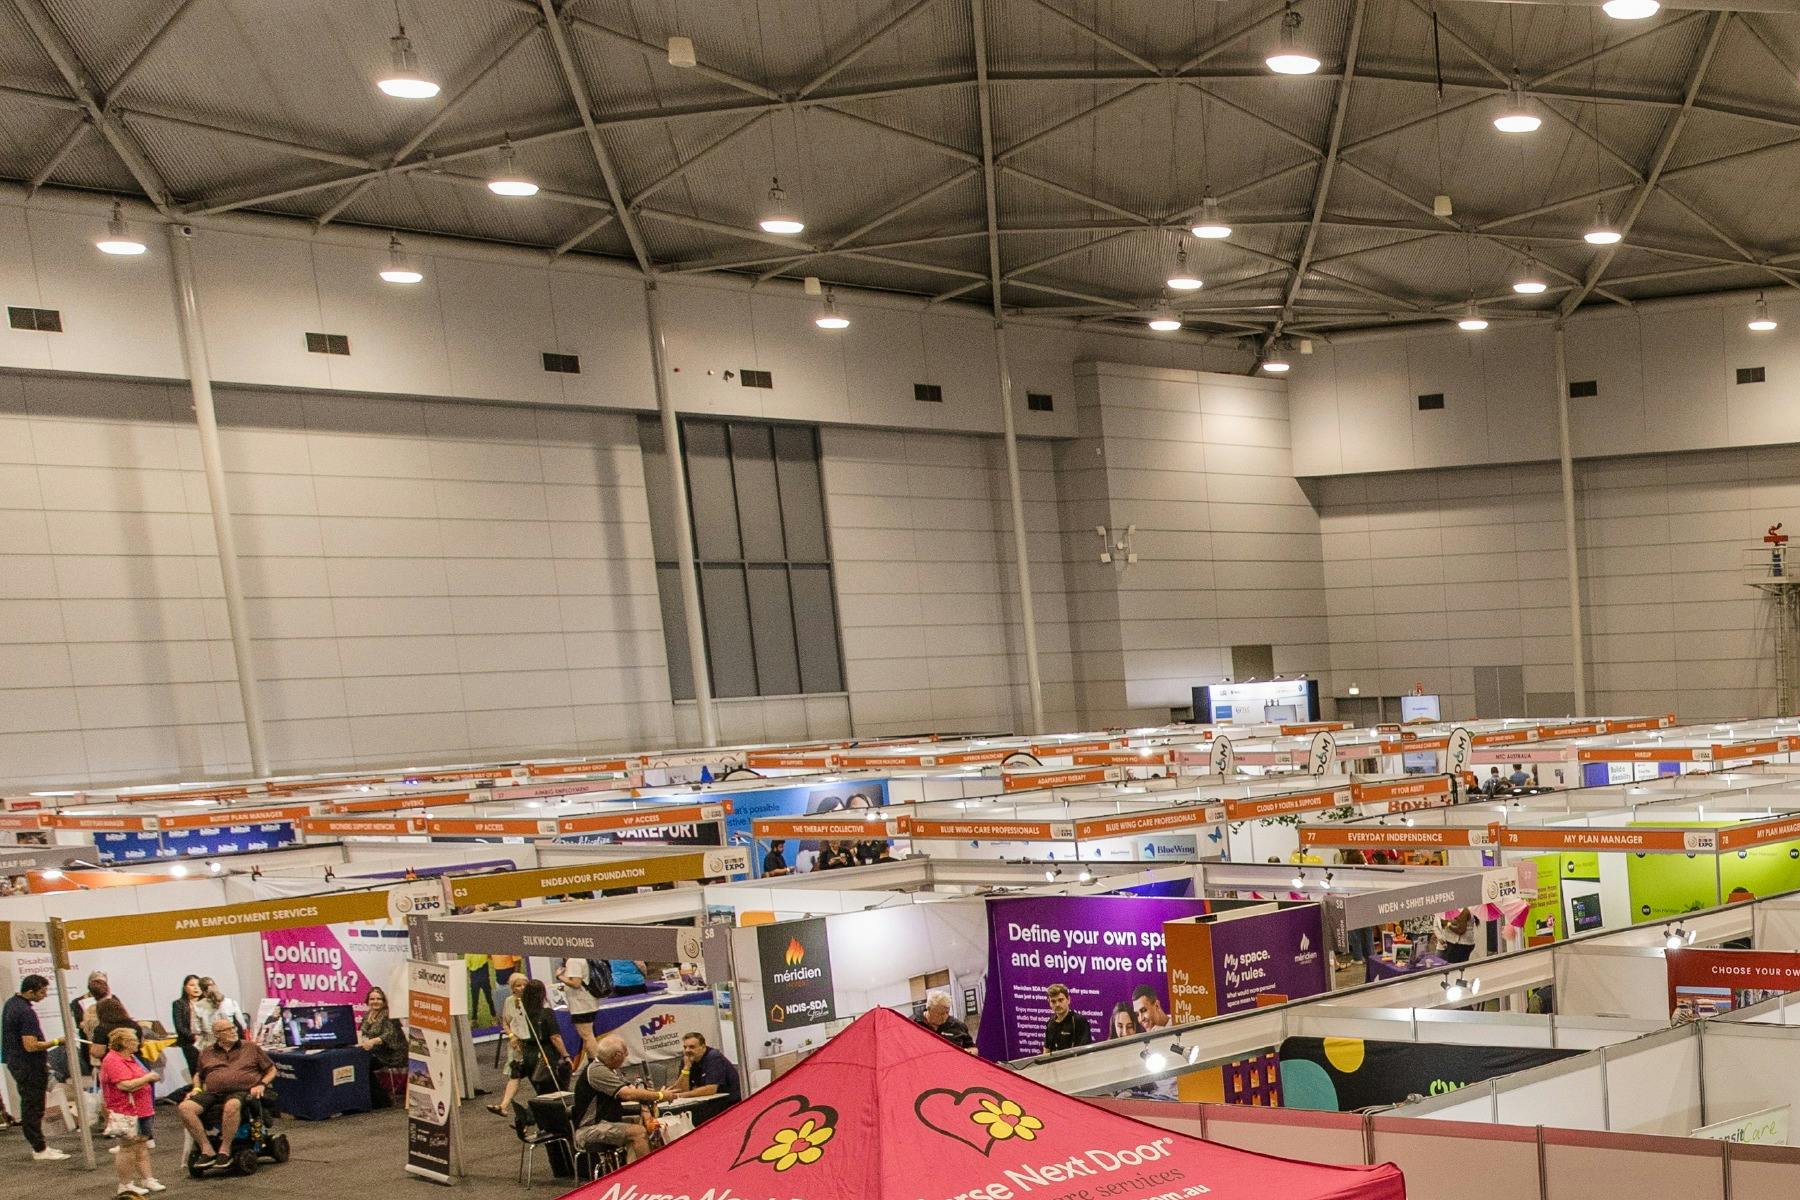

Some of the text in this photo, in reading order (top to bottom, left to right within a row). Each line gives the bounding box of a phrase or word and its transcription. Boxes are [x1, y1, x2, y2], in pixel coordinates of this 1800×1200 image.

[624, 814, 660, 824] VIP ACCESS
[940, 826, 955, 834] BLUE
[956, 826, 974, 834] WING
[975, 826, 991, 834] CARE
[992, 826, 1040, 835] PROFESSIONALS
[1307, 832, 1442, 842] 77 EVERYDAY INDEPENDENCE
[1508, 834, 1643, 844] 78 MY PLAN MANAGER
[725, 862, 745, 870] EXPO
[454, 867, 645, 898] G3 ENDEAVOUR FOUNDATION
[414, 902, 439, 910] EXPO
[1378, 902, 1398, 914] WDEN
[1406, 898, 1424, 909] SHHIT
[1425, 891, 1455, 905] HAPPENS
[68, 907, 318, 940] G4 APM EMPLOYMENT SERVICES
[523, 936, 563, 947] SILKWOOD
[565, 937, 594, 948] HOMES
[1008, 922, 1167, 951] Define your own spa
[262, 939, 342, 970] Looking
[1011, 950, 1040, 968] and
[1044, 951, 1086, 974] enjoy
[1091, 955, 1132, 972] more
[1135, 956, 1153, 972] of
[1224, 950, 1271, 971] My space.
[774, 967, 821, 984] méridien
[1173, 969, 1189, 985] My
[1226, 967, 1266, 988] My rules.
[1712, 966, 1752, 975] CHOOSE
[1755, 967, 1781, 976] YOUR
[266, 967, 359, 993] For work?
[1173, 984, 1208, 996] space.
[786, 1000, 828, 1015] NDIS-SDA
[1176, 1000, 1191, 1015] My
[1005, 1154, 1092, 1195] Next
